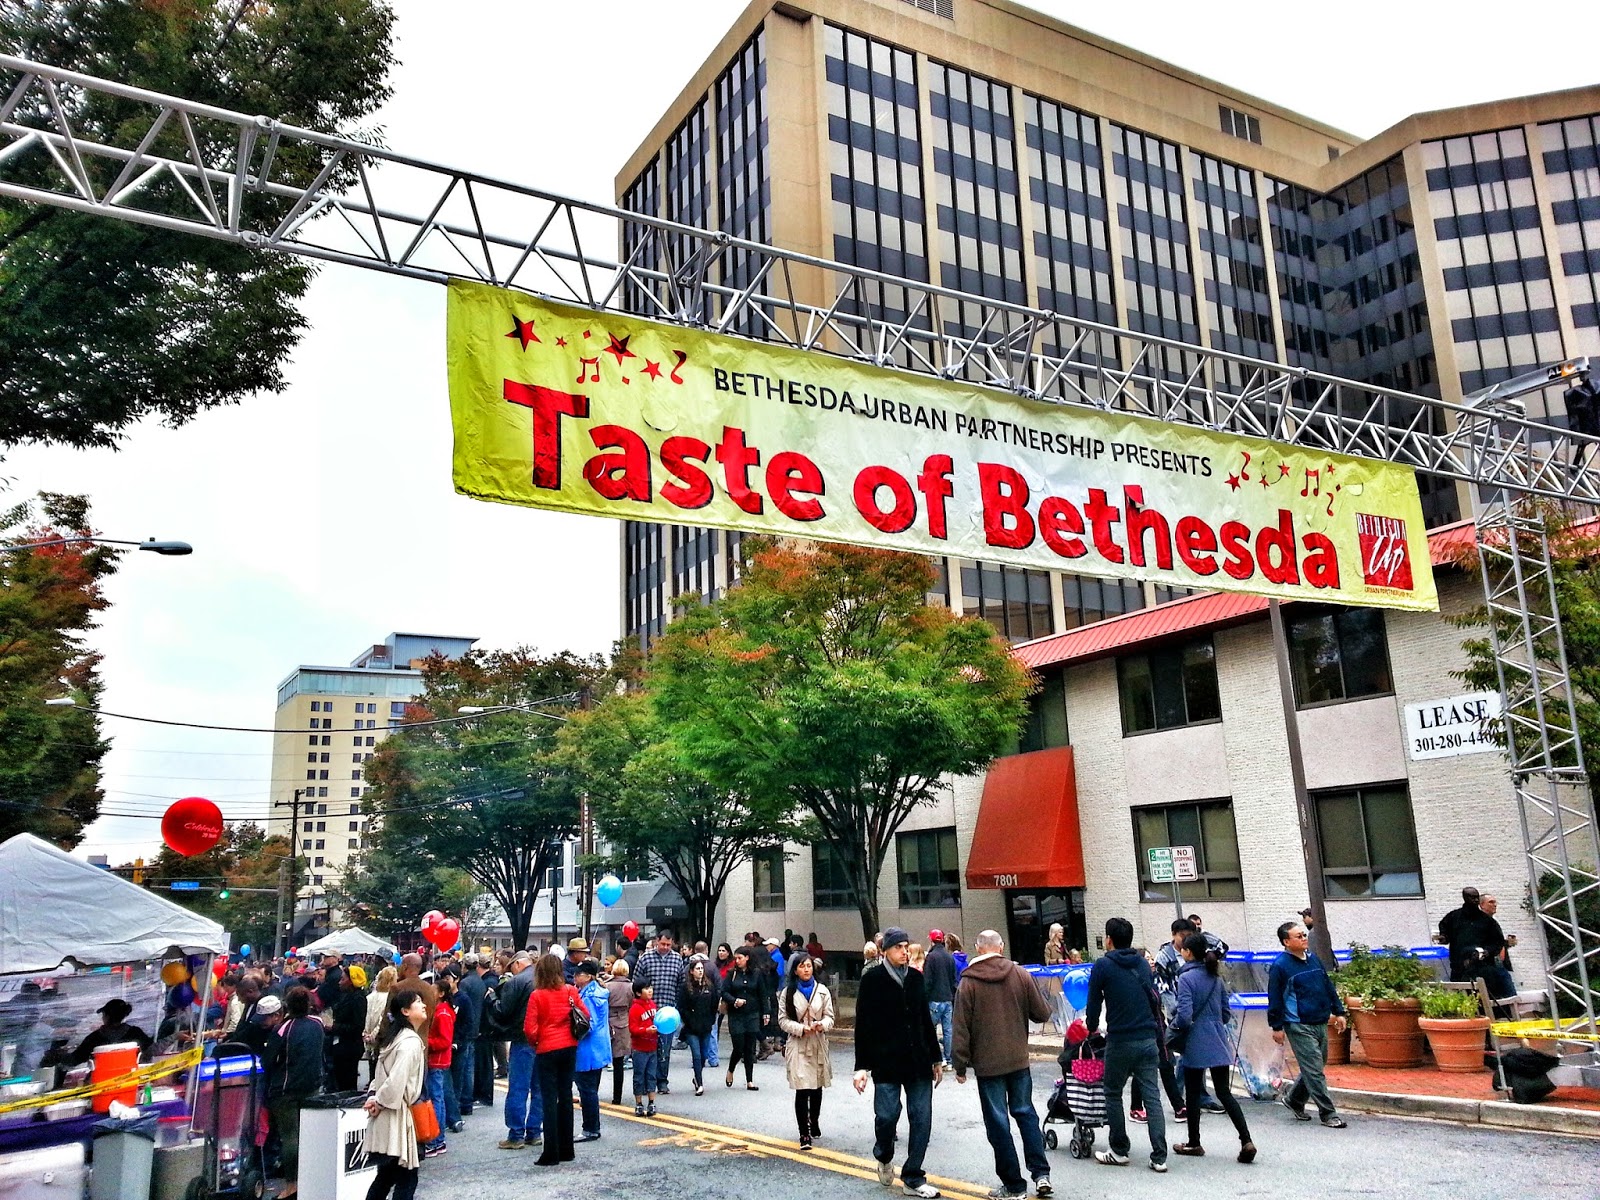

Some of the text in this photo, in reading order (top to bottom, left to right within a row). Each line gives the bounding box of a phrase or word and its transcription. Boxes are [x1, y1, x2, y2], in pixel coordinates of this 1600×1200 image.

[714, 367, 1213, 477] BETHESDA URBAN PARTNERSHIP PRESENTS
[503, 378, 1341, 590] Taste of Bethesda
[1356, 513, 1407, 541] BETHESDA
[1418, 700, 1489, 729] LEASE
[993, 874, 1018, 887] 7801
